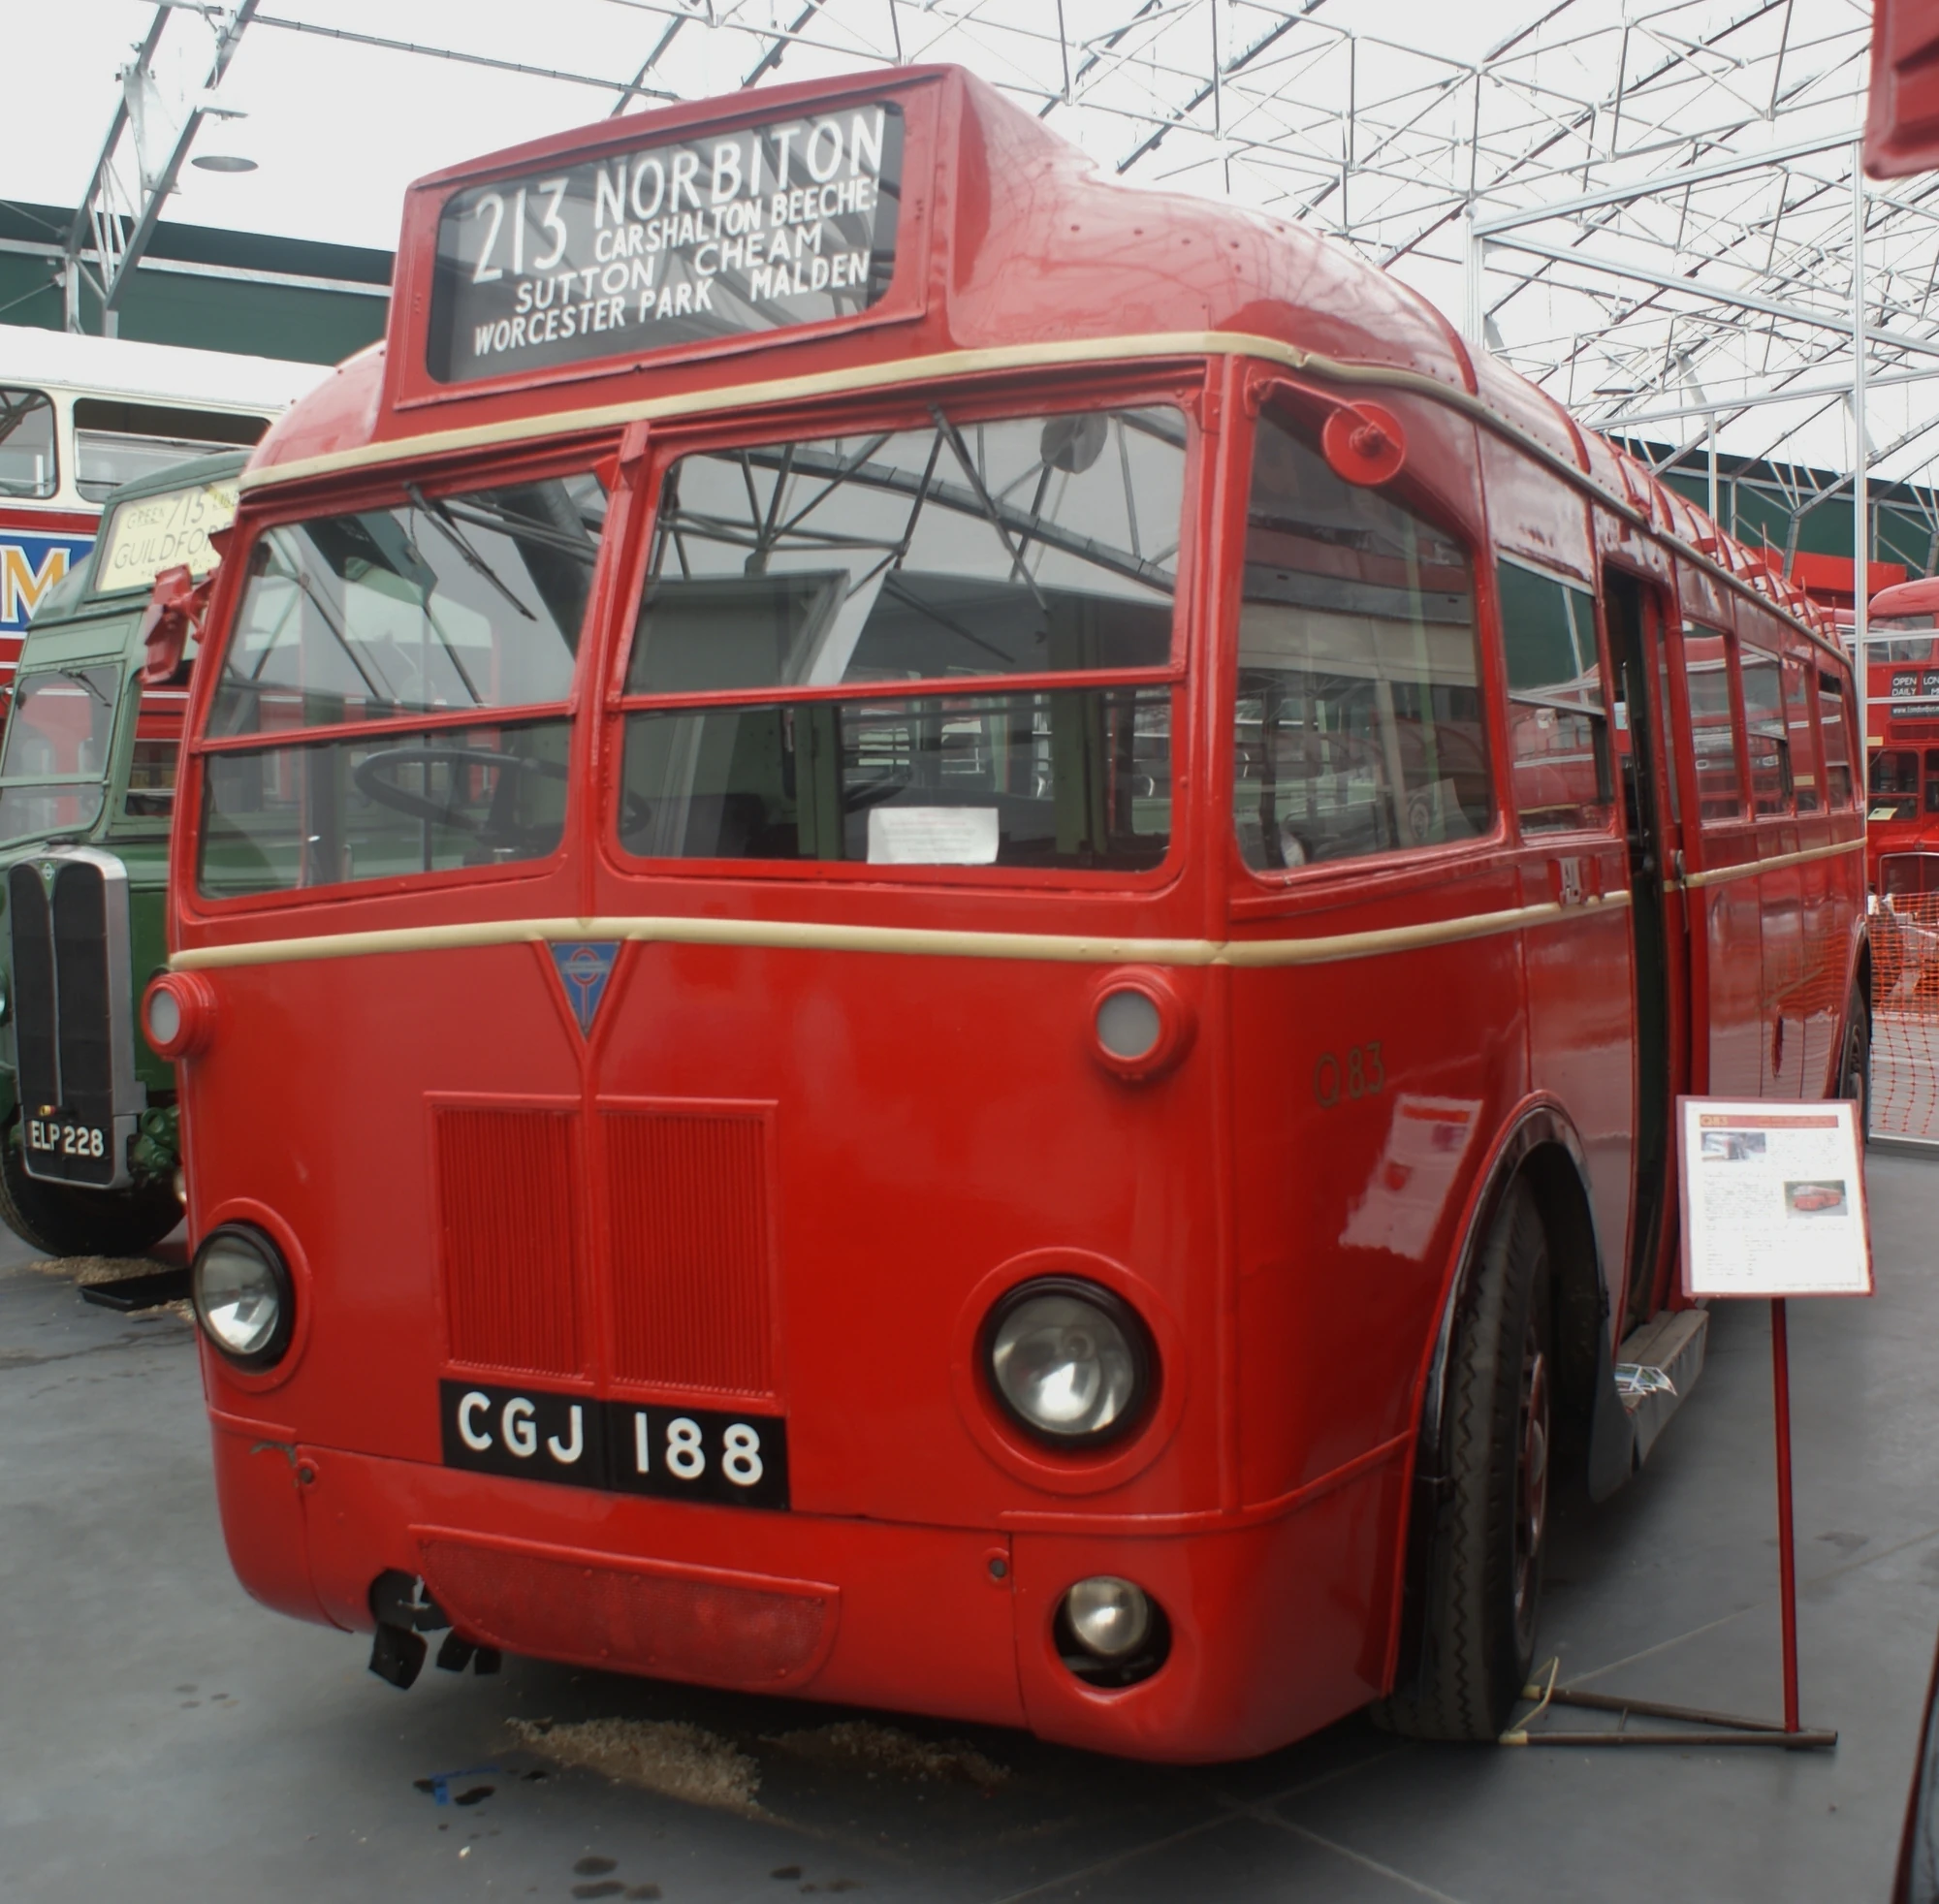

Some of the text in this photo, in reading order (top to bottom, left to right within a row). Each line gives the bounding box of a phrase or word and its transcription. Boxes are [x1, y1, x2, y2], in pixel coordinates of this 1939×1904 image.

[593, 106, 886, 230] NORBITON
[471, 176, 569, 285] 213
[515, 223, 823, 315] SUTTON CHEAM
[594, 200, 762, 264] CARSHALTON
[473, 250, 872, 358] WORCESTER PARK MALDEN
[1891, 687, 1917, 697] DAILY
[1892, 677, 1917, 686] OPEN
[30, 1120, 105, 1158] ELP 228
[458, 1390, 764, 1486] CGJ 188
